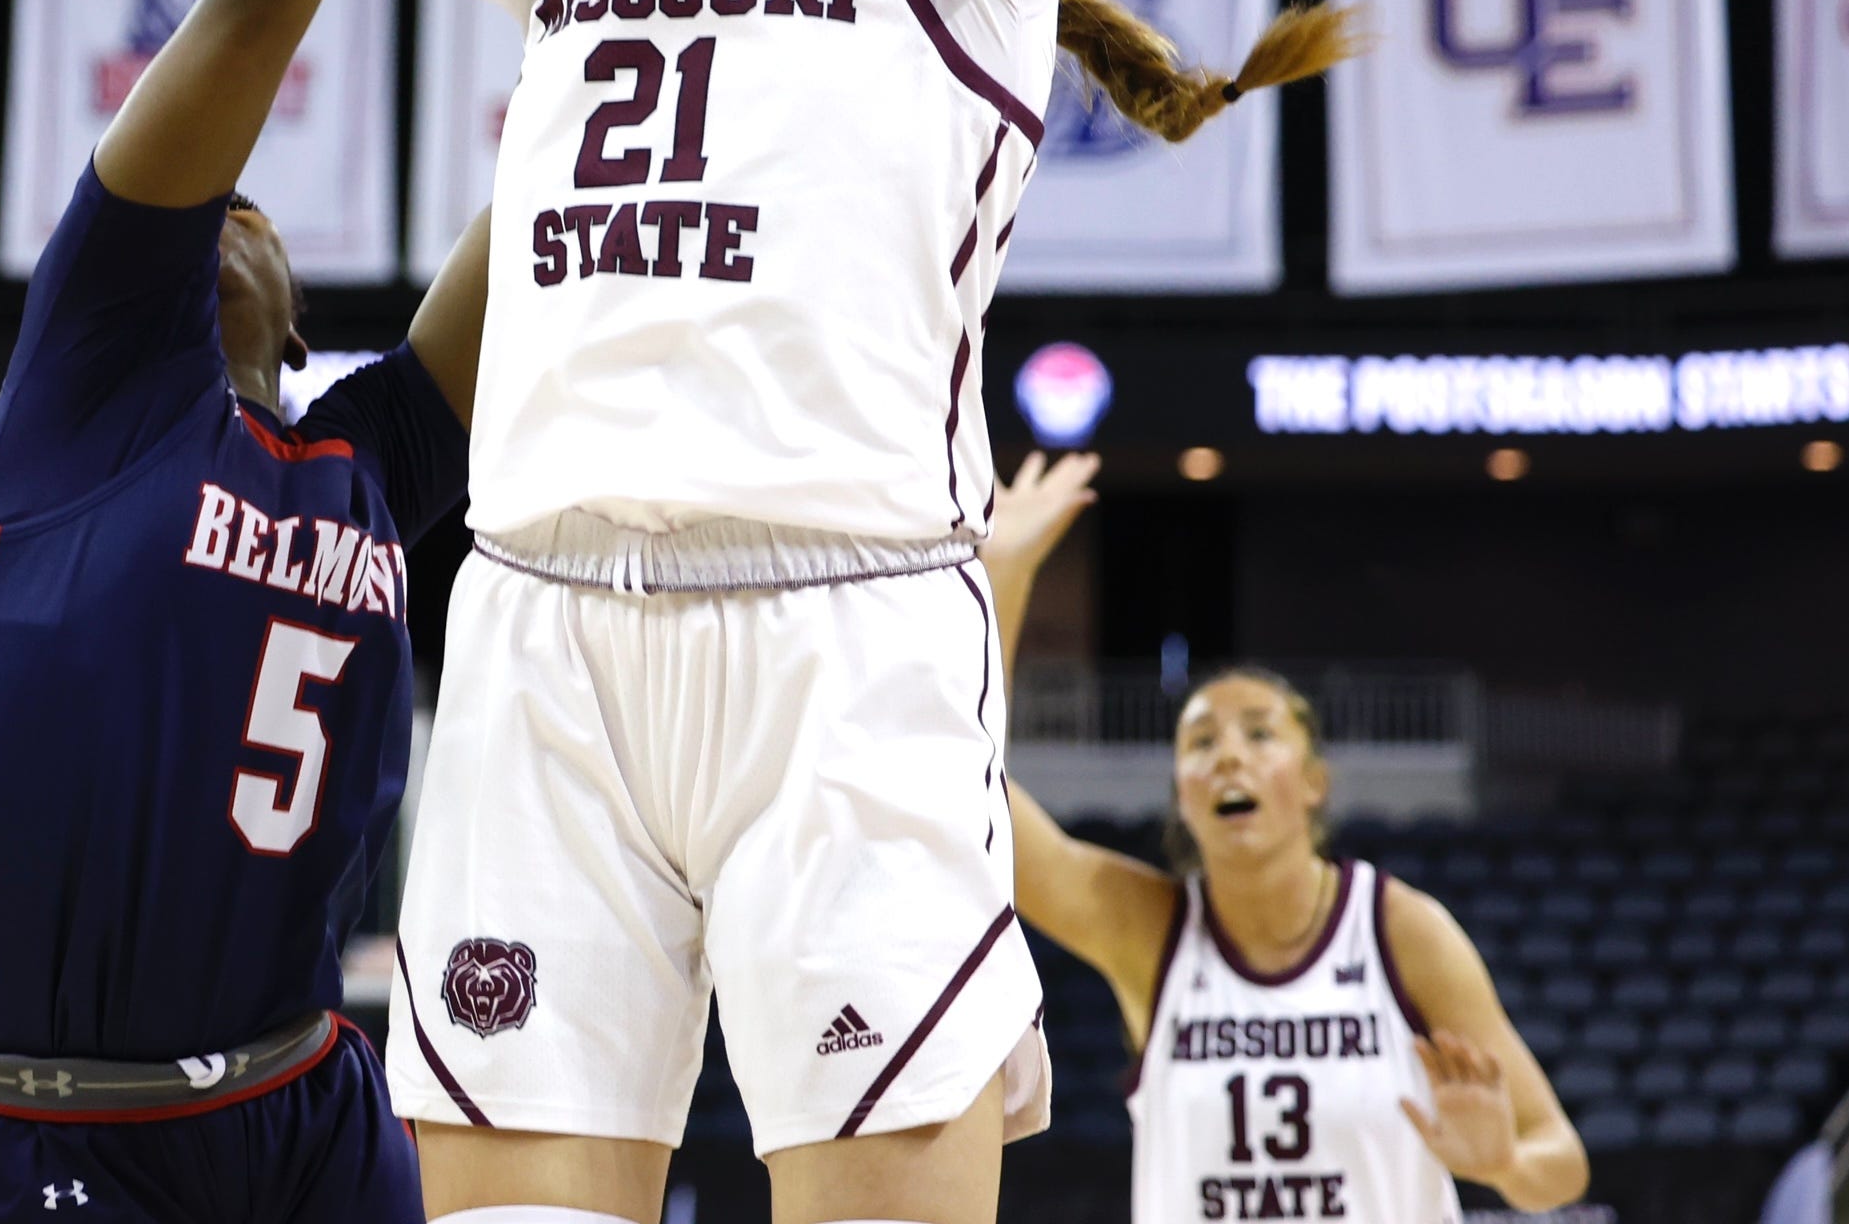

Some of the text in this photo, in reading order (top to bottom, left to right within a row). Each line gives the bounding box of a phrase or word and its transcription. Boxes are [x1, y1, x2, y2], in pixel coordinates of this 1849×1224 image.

[573, 37, 716, 189] 21
[533, 200, 759, 287] STATE
[228, 614, 360, 857] 5
[816, 1031, 884, 1056] adidas
[1172, 1013, 1380, 1061] MISSOURI
[1225, 1072, 1311, 1163] 13
[1200, 1171, 1345, 1220] STATE
